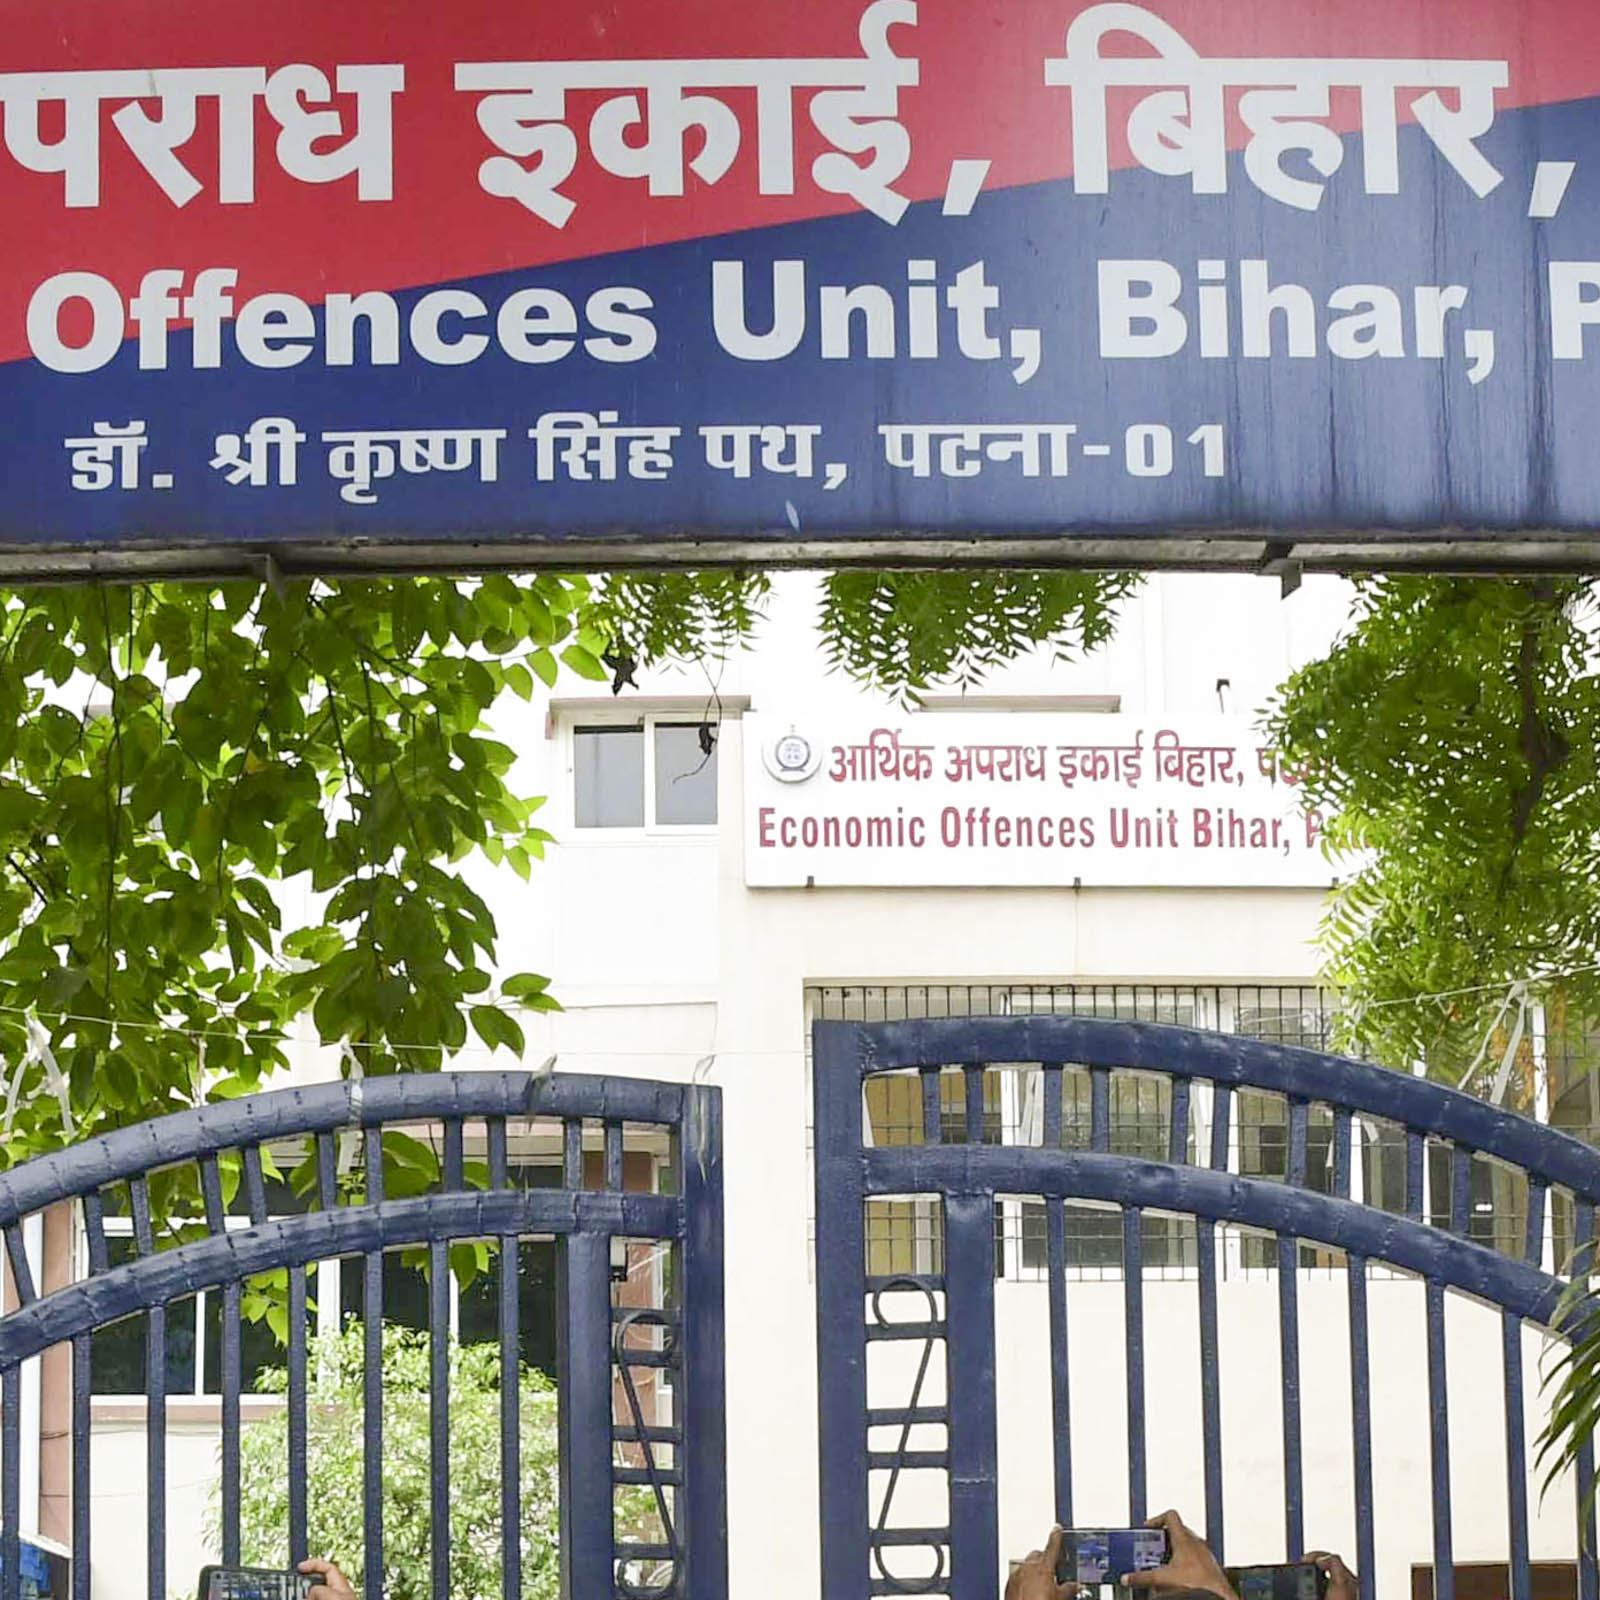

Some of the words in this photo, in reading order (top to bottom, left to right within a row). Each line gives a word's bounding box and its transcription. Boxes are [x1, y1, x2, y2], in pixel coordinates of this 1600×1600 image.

[455, 0, 992, 228] इकाई,
[1044, 3, 1575, 217] बिहार,
[27, 269, 656, 372] Offences
[713, 260, 1041, 384] Unit,
[1097, 258, 1495, 385] Bihar,
[65, 421, 172, 491] डॉ.
[210, 418, 305, 487] श्री
[322, 430, 506, 503] कृष्ण
[529, 411, 680, 482] सिंह
[699, 426, 846, 491] पथ,
[878, 424, 1224, 482] पटना-01
[829, 729, 934, 783] आर्थिक
[944, 745, 1046, 783] अपराध
[1056, 729, 1143, 788] इकाई
[1154, 730, 1244, 787] बिहार,
[759, 807, 926, 849] Economic
[941, 806, 1095, 849] Offences
[1111, 806, 1178, 849] Unit
[1193, 807, 1291, 856] Bihar,
